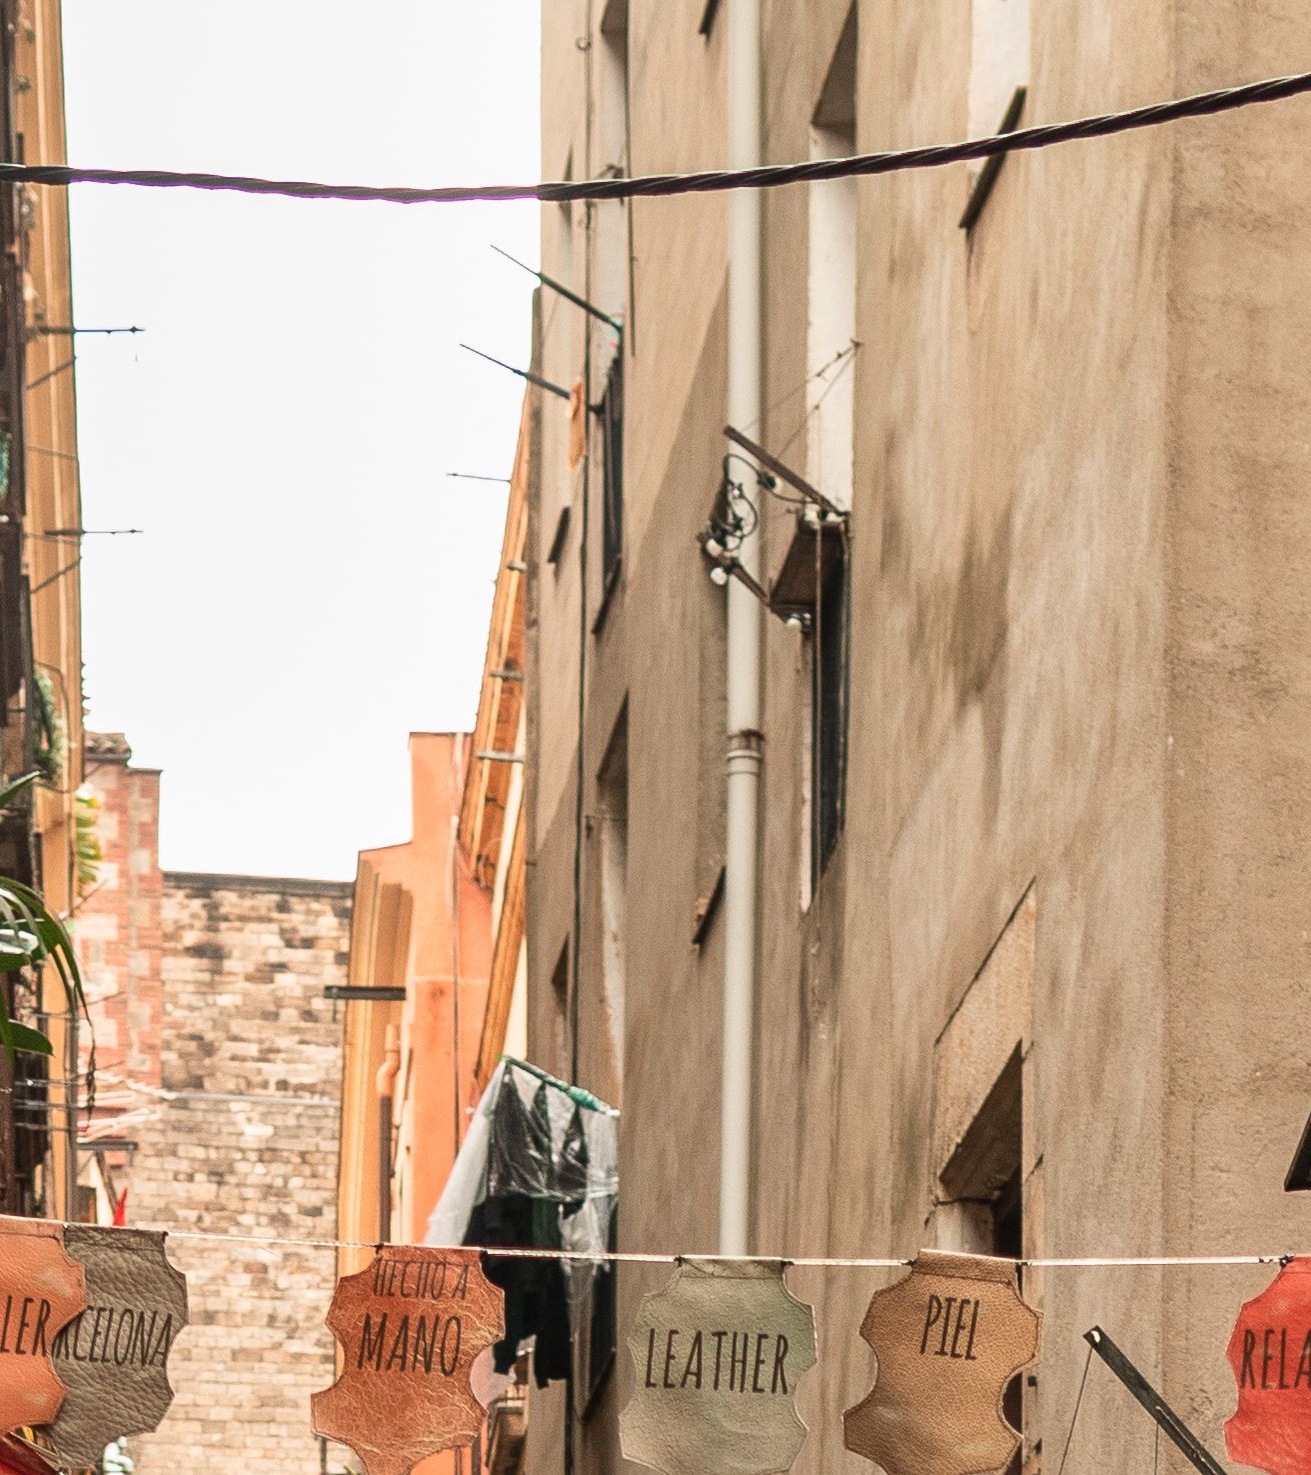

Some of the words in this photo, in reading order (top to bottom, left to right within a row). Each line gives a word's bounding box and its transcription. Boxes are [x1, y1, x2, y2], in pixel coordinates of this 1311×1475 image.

[374, 1260, 446, 1299] HECHO
[451, 1264, 468, 1300] A
[357, 1314, 462, 1377] MANO
[920, 1294, 980, 1361] PIEL
[644, 1328, 789, 1396] LEATHER
